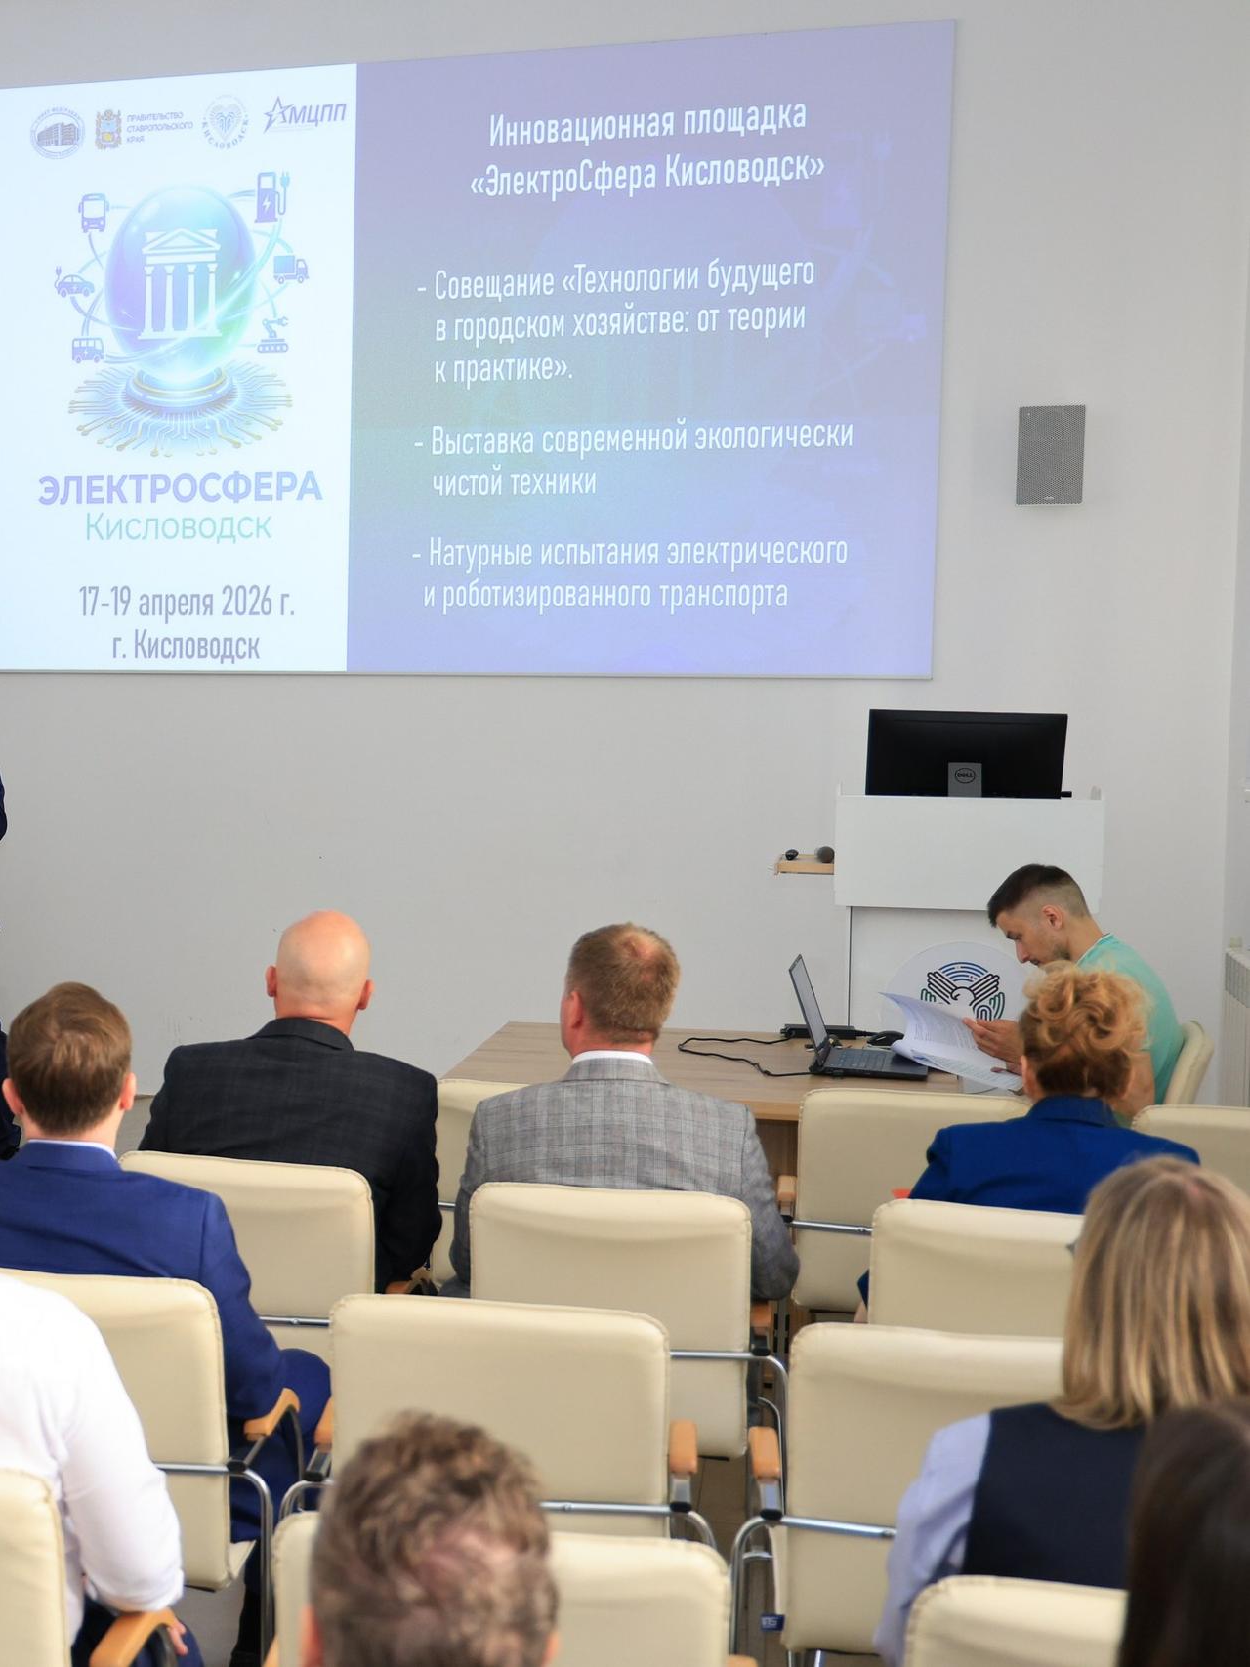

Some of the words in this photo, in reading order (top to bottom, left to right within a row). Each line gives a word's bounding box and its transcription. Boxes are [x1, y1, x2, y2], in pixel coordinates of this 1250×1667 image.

[126, 111, 184, 122] ПРАВИТЕЛЬСТВО
[126, 121, 193, 133] СТАВРОПОЛЬСКОГО
[489, 113, 674, 147] Инновационная
[684, 103, 807, 135] площадка
[126, 135, 146, 143] КРАЯ
[471, 158, 656, 201] «ЭлектроСфера
[665, 153, 825, 188] Кисловодск»
[435, 269, 555, 302] Совещание
[562, 264, 698, 295] «Технологии
[707, 258, 814, 297] будущего
[436, 319, 446, 341] в
[454, 313, 565, 348] городском
[573, 301, 688, 337] хозяйстве:
[697, 310, 719, 332] от
[728, 305, 806, 337] теории
[435, 360, 446, 382] к
[453, 356, 572, 389] практике».
[433, 425, 533, 455] Выставка
[543, 418, 687, 460] современной
[695, 421, 854, 451] экологически
[38, 470, 323, 505] ЭЛЕКТРОСФЕРА
[433, 465, 502, 496] чистой
[511, 470, 597, 495] техники
[85, 513, 272, 544] Кисловодск
[429, 538, 532, 574] Натурные
[540, 541, 659, 573] испытания
[667, 538, 848, 573] электрического
[79, 585, 132, 616] 17-19
[139, 590, 213, 624] апреля
[222, 585, 272, 616] 2026
[280, 590, 295, 616] г.
[424, 588, 436, 608] и
[442, 579, 650, 615] роботизированного
[659, 581, 788, 615] транспорта
[112, 634, 126, 660] г.
[134, 629, 260, 663] Кисловодск
